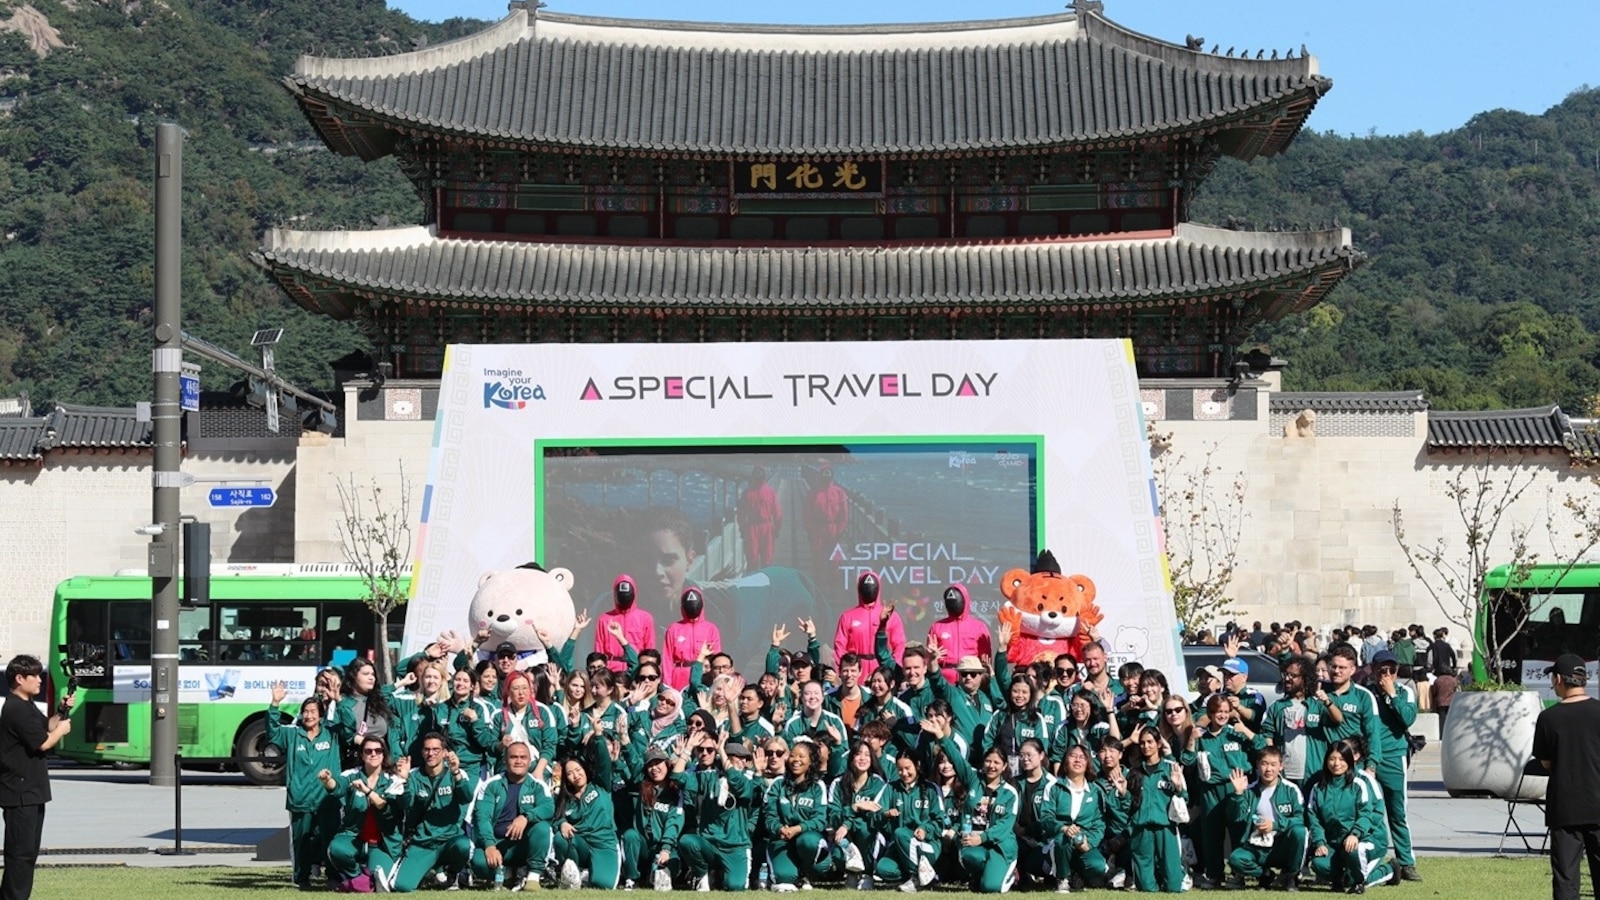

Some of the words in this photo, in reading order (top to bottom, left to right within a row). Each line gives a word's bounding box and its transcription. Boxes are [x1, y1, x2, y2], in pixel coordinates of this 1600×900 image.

[483, 368, 523, 378] Imagine
[508, 377, 532, 386] your
[484, 381, 547, 410] Korea
[580, 376, 603, 400] A
[609, 376, 773, 408] SPECIAL
[784, 374, 921, 406] TRAVEL
[932, 373, 998, 396] DAY
[229, 489, 253, 498] 사직로
[829, 543, 847, 561] A
[851, 543, 974, 561] SPECIAL
[949, 566, 999, 584] DAY
[934, 600, 1000, 612] 한광공사
[438, 785, 452, 796] 013
[798, 797, 814, 808] 077
